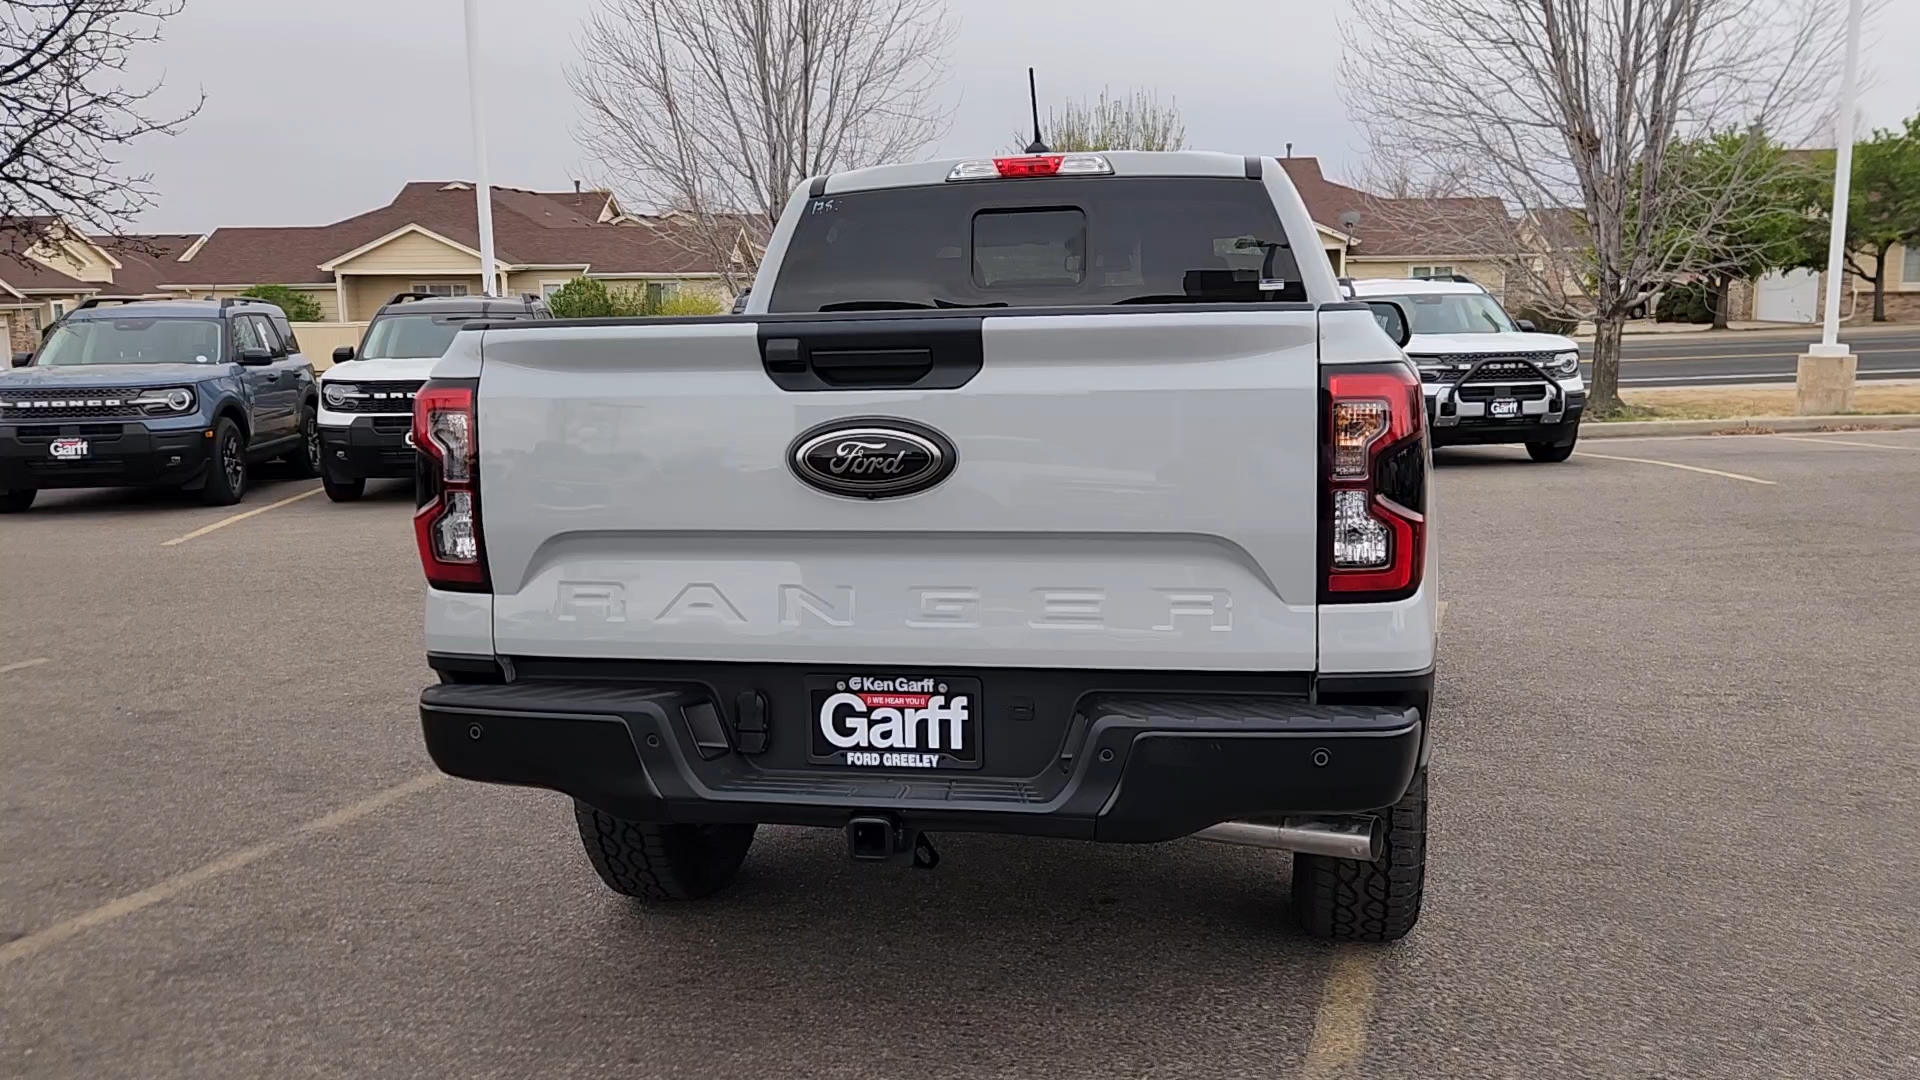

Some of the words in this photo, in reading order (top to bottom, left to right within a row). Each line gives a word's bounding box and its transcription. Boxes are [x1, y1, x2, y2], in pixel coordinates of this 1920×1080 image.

[17, 400, 120, 408] BRONCO
[1491, 402, 1518, 413] Garff
[50, 441, 88, 456] Garff
[830, 441, 905, 474] Ford
[556, 580, 1233, 631] RANGER
[863, 677, 893, 691] Ken
[895, 678, 934, 692] Garff
[873, 696, 884, 704] WE
[885, 696, 904, 704] HEAR
[905, 697, 921, 705] YOU
[820, 692, 968, 750] Garff
[847, 752, 880, 765] FORD
[883, 753, 939, 767] GREELEY
